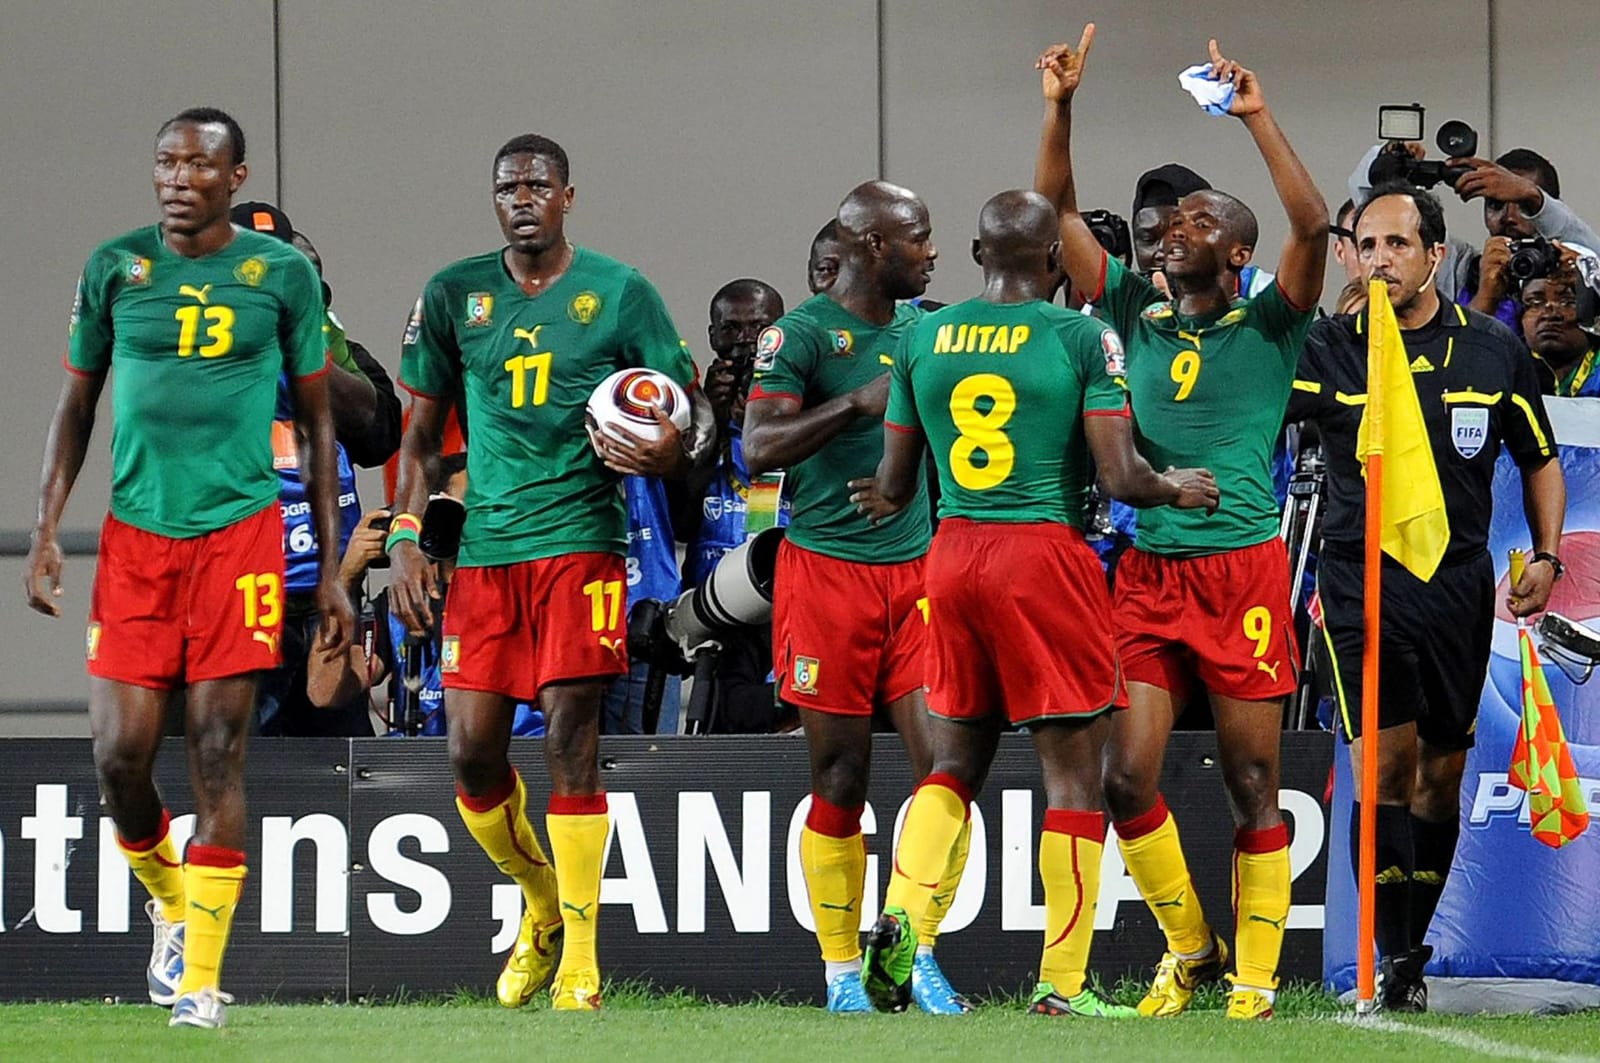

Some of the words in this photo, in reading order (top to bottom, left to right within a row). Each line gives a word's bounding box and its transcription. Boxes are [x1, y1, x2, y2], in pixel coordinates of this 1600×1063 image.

[175, 305, 235, 357] 13
[934, 323, 1030, 354] NJITAP
[504, 352, 552, 408] 17
[1170, 350, 1201, 401] 9
[949, 373, 1017, 490] 8
[1457, 426, 1482, 438] FIFA
[338, 493, 356, 507] ER
[235, 572, 281, 628] 13
[583, 579, 622, 632] 17
[1242, 606, 1272, 658] 9
